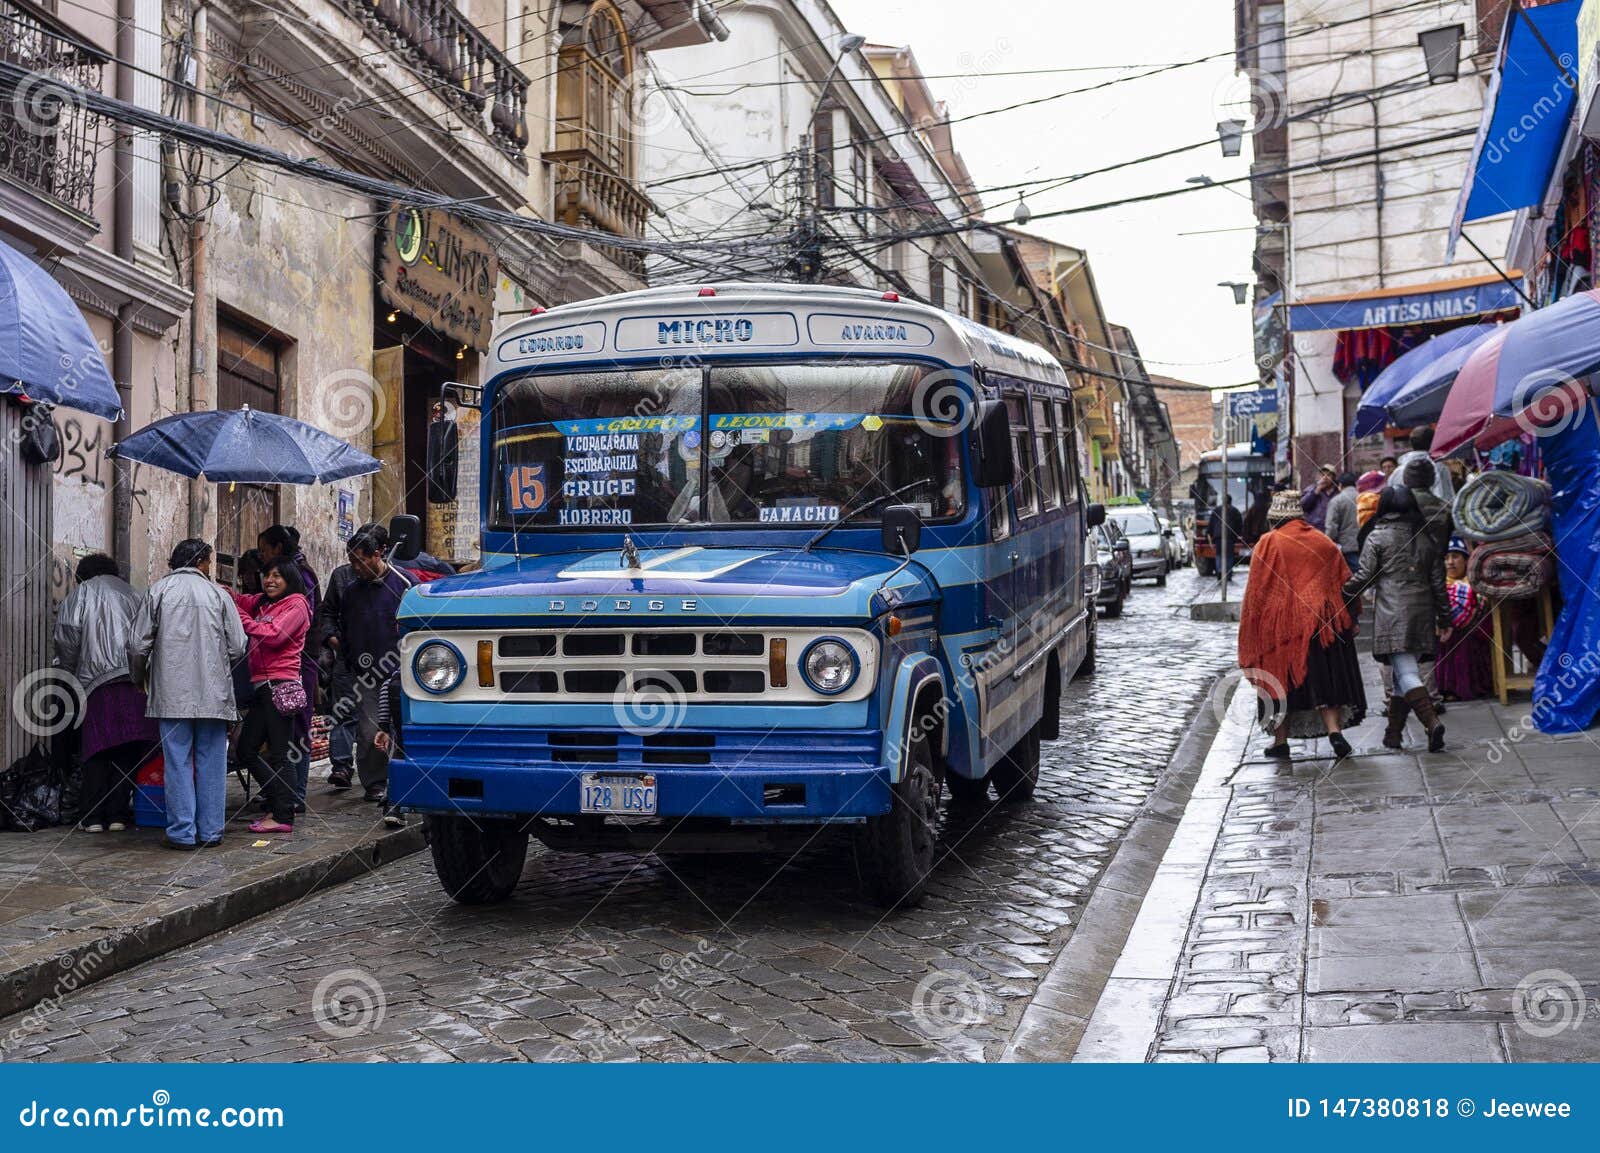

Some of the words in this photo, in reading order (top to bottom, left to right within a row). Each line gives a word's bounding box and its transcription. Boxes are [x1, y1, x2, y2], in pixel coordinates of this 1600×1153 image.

[1363, 295, 1477, 326] ARTESANIAS
[657, 318, 753, 345] MICRO
[508, 465, 546, 510] 15
[563, 479, 636, 497] CRUCE
[759, 506, 840, 523] CAMACHO
[549, 599, 698, 612] DODGE
[584, 786, 612, 809] 128
[622, 786, 653, 809] USC
